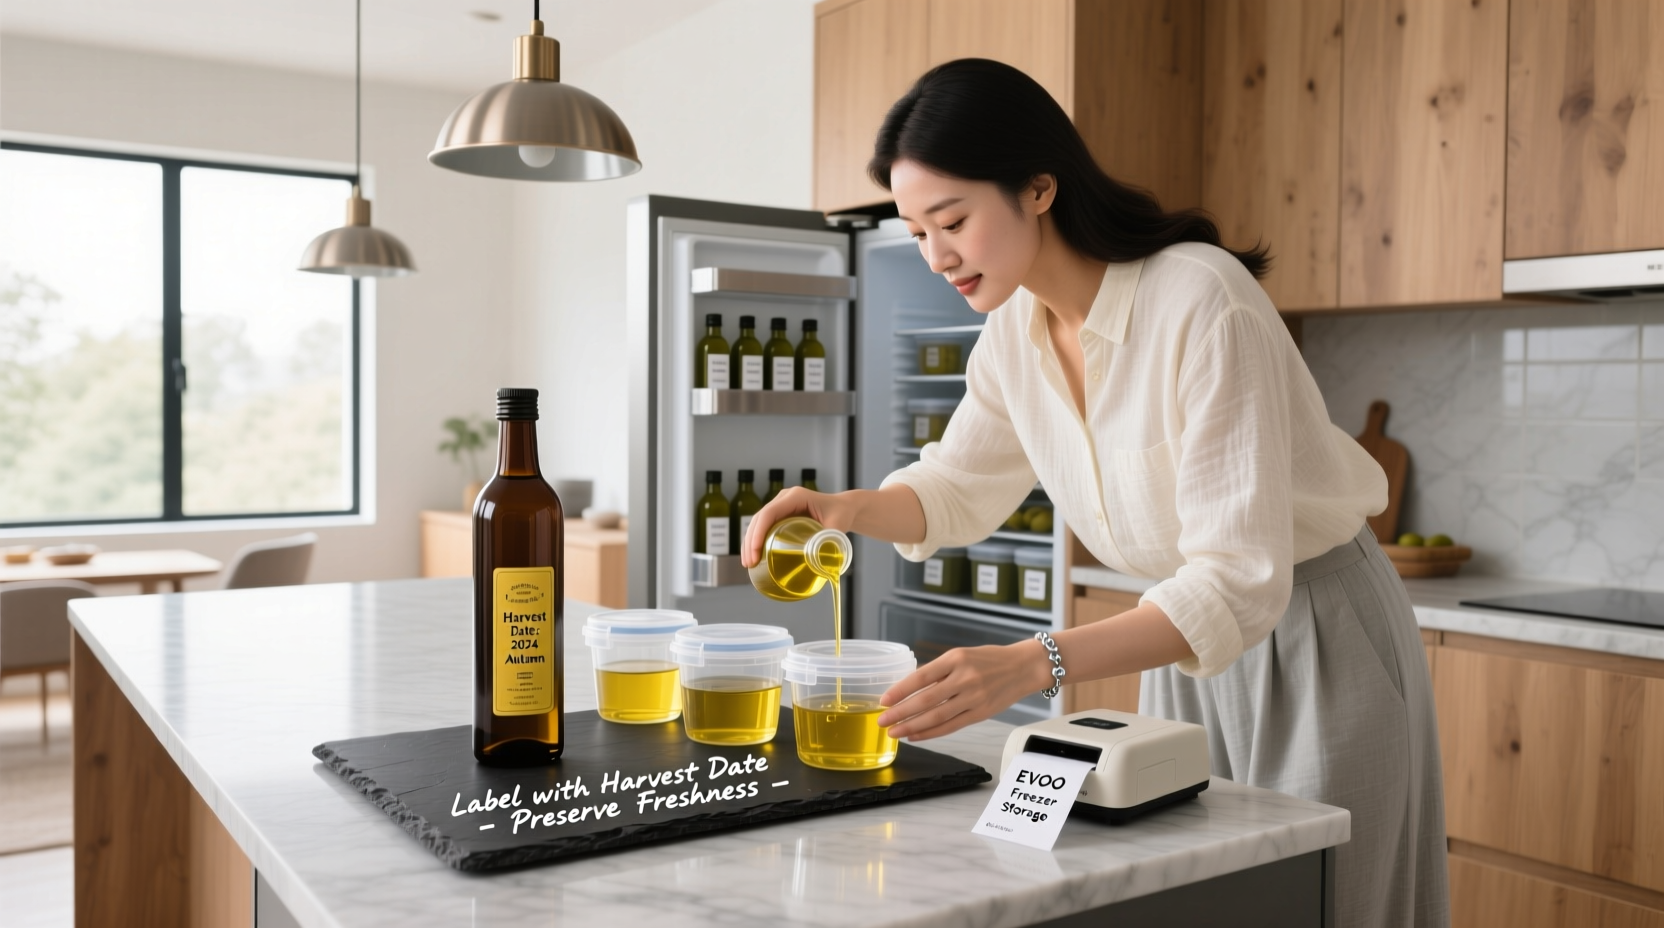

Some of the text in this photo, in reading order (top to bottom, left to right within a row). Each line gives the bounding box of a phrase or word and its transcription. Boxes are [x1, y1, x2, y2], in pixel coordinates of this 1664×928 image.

[503, 612, 547, 623] Harvest
[451, 753, 769, 817] Label with Harvest Date
[1015, 769, 1066, 790] EVOO
[510, 799, 621, 835] Preserve
[636, 779, 759, 814] Freshness
[1010, 787, 1058, 807] Freezer
